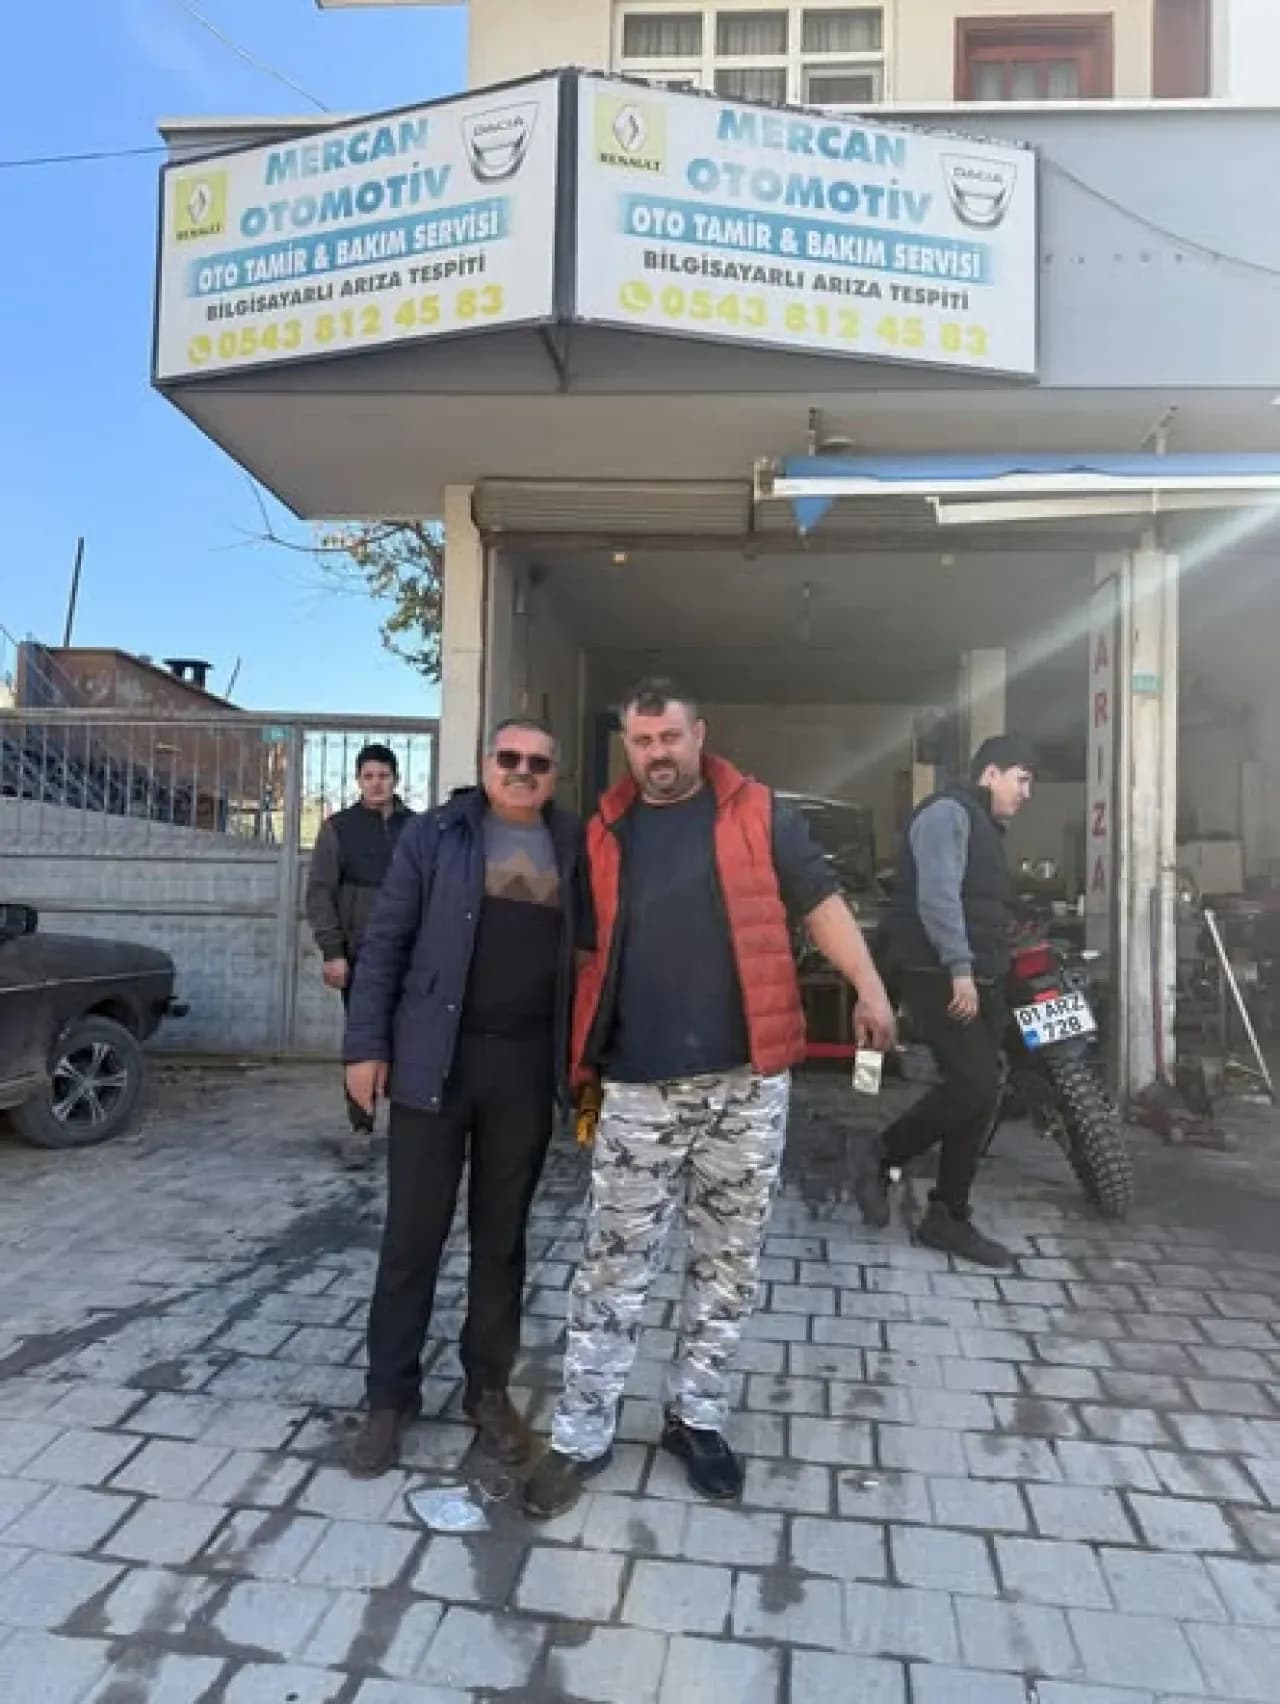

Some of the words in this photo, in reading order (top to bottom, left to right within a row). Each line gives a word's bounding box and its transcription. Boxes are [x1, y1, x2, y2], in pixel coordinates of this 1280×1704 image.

[265, 119, 430, 186] MERCAN
[717, 109, 907, 167] MERCAN
[240, 162, 453, 237] OTOMOTİV
[687, 157, 932, 223] OTOMOTİV
[199, 263, 238, 291] OTO
[245, 244, 308, 283] TAMİR
[314, 249, 328, 267] &
[337, 232, 406, 265] BAKIM
[415, 207, 499, 249] SERVİSİ
[632, 205, 684, 237] OTO
[694, 213, 772, 249] TAMİR
[779, 232, 798, 253] &
[807, 234, 887, 267] BAKIM
[895, 244, 981, 280] SERVİSİ
[207, 279, 333, 322] BİLGİSAYARLI
[340, 272, 401, 299] ARIZA
[409, 253, 486, 285] TESPİTİ
[643, 249, 804, 290] BİLGİSAYARLI
[812, 273, 882, 300] ARIZA
[889, 283, 969, 310] TESPİTİ
[218, 320, 301, 359] 0543
[314, 305, 381, 343] 812
[394, 294, 441, 329] 45
[661, 286, 768, 328] 0543
[784, 306, 860, 340] 812
[876, 316, 926, 348] 45
[1092, 632, 1109, 893] ARIZA
